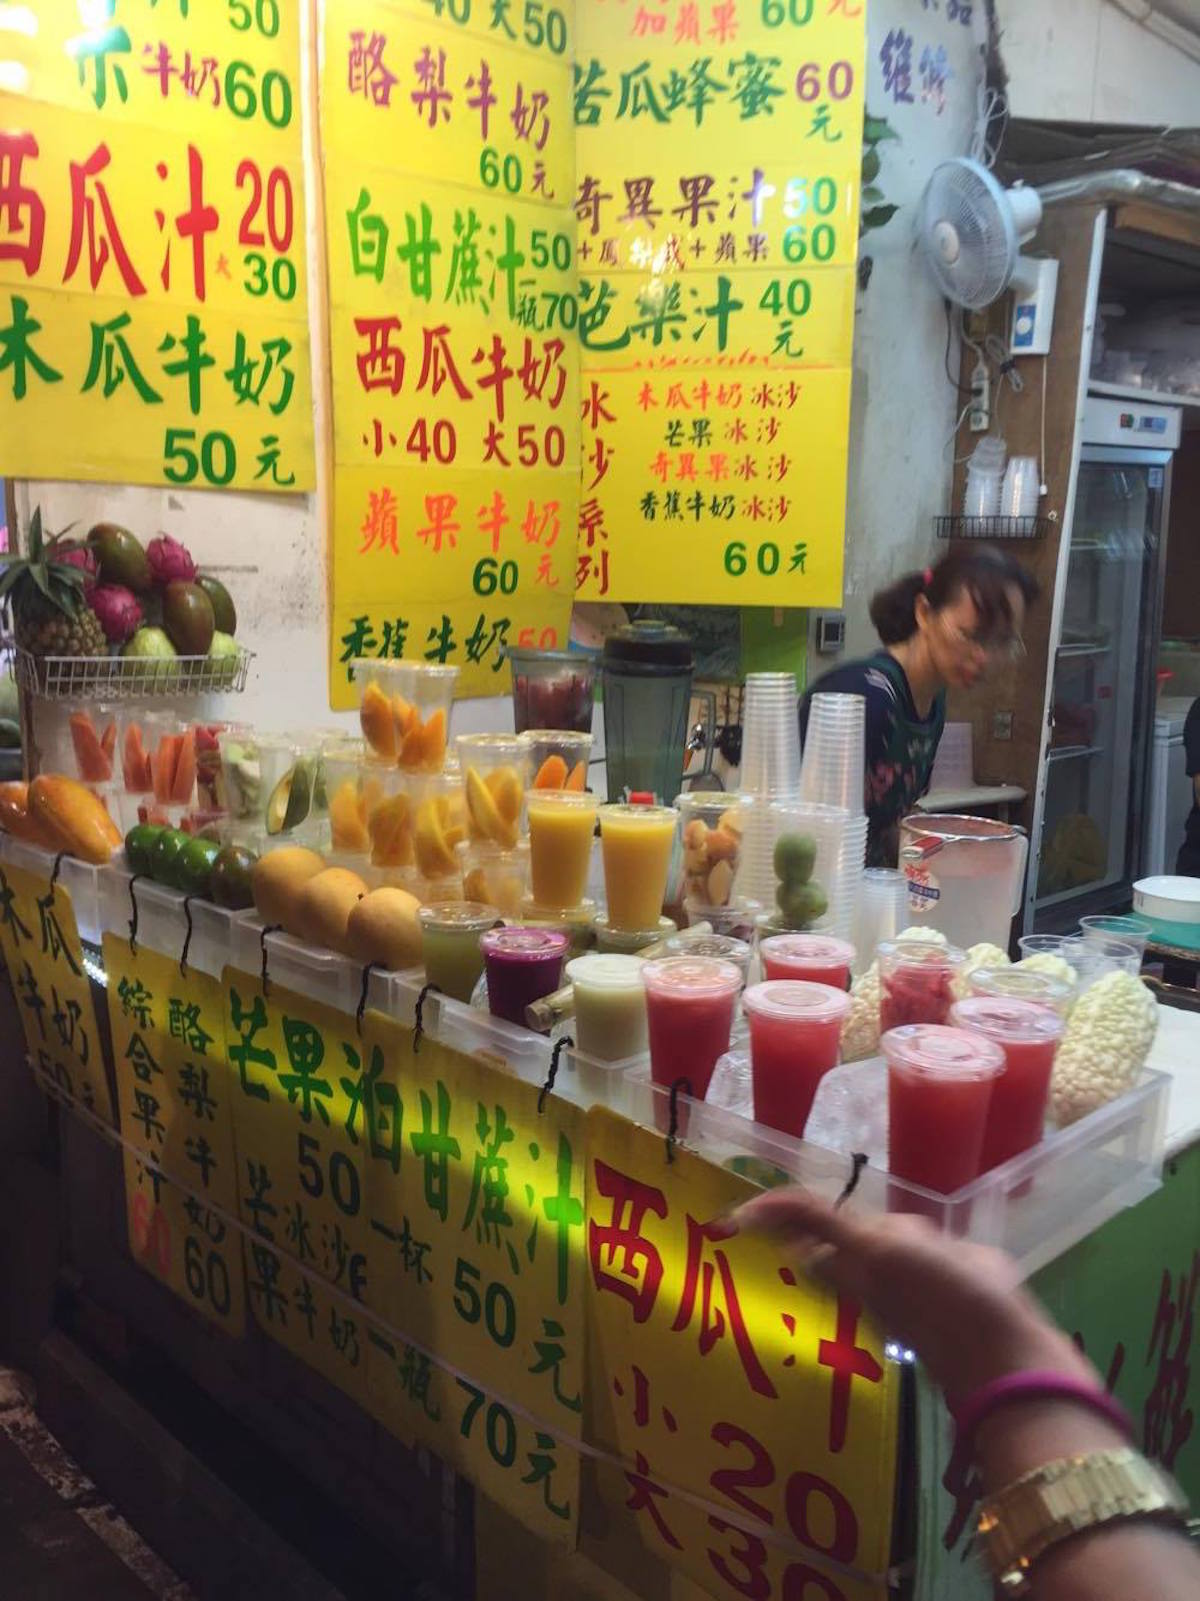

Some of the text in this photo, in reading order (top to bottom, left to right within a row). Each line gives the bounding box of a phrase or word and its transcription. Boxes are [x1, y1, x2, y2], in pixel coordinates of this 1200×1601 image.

[224, 60, 293, 128] 60
[347, 30, 550, 151] 酪梨牛奶
[573, 51, 853, 127] 苦瓜蜂蜜 60
[806, 104, 843, 142] 元
[0, 131, 294, 303] 西瓜汁 20
[573, 167, 838, 236] 奇異果汁 50
[243, 253, 297, 301] 30
[346, 187, 571, 320] 白甘蔗汁 50
[782, 223, 836, 264] 60
[541, 292, 578, 330] 70
[759, 279, 812, 317] 40
[0, 294, 295, 416] 木瓜牛奶
[354, 316, 567, 423] 西瓜牛奶
[771, 320, 804, 358] 元
[359, 486, 561, 555] 蘋果牛奶
[299, 1131, 361, 1217] 50
[361, 1043, 584, 1306] 白甘蔗汁
[184, 1235, 232, 1317] 60
[589, 1158, 884, 1454] 西瓜汁
